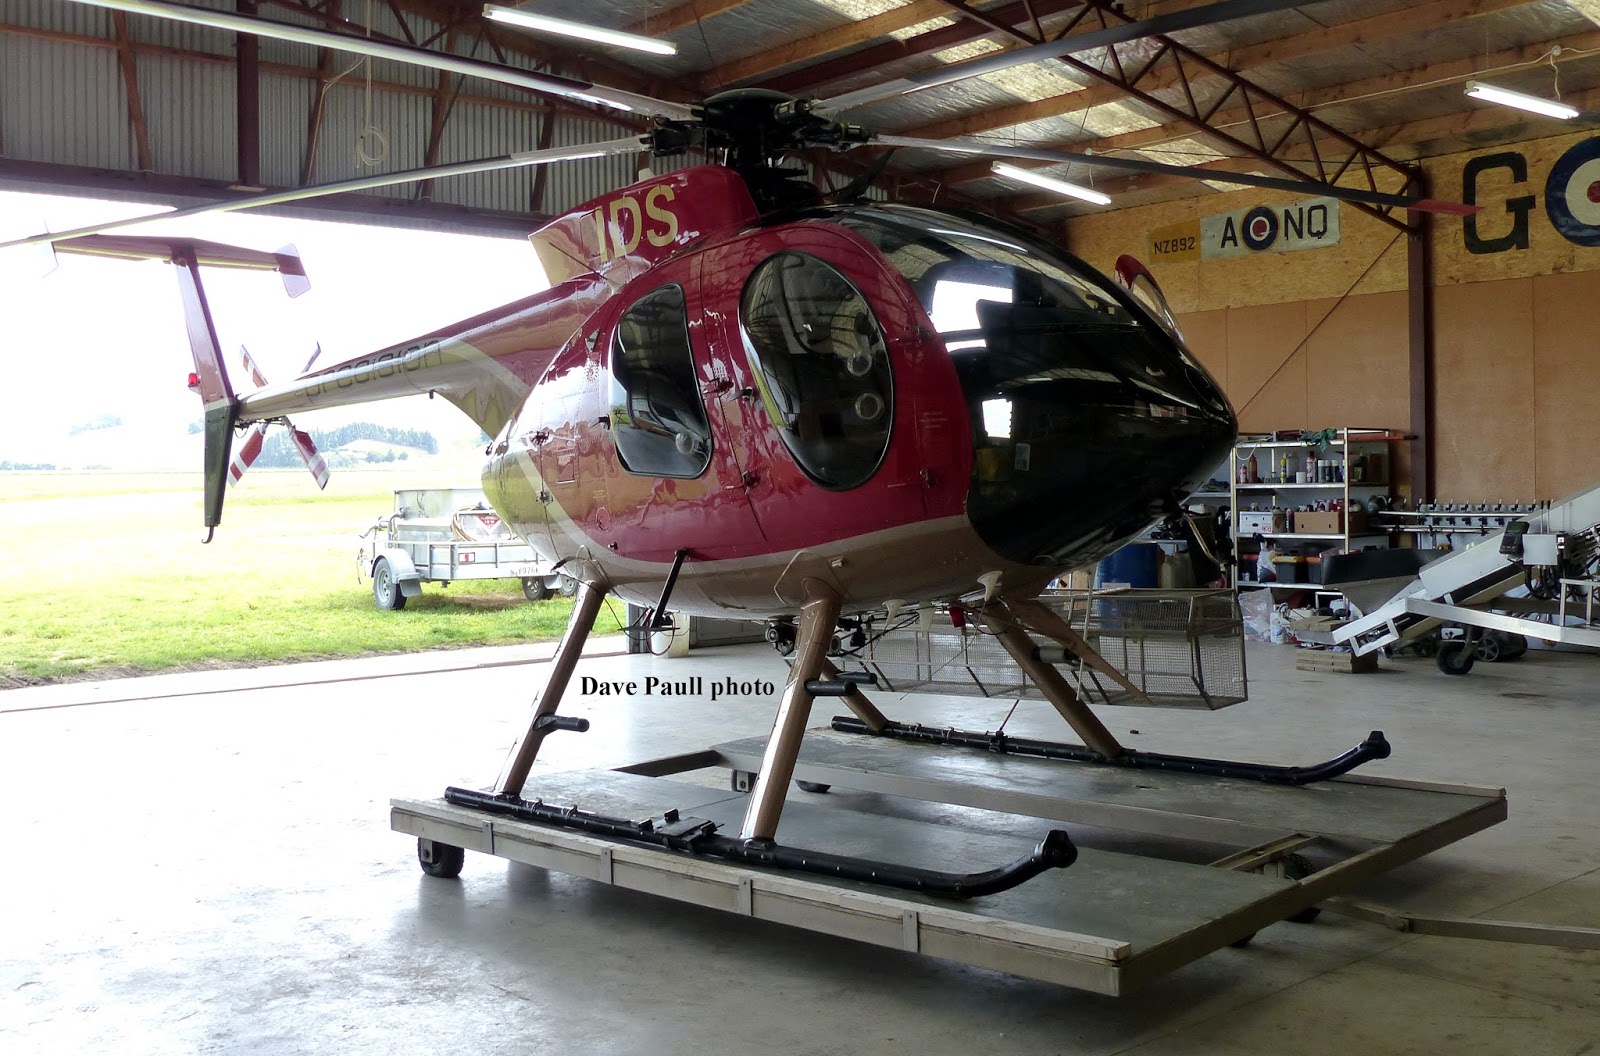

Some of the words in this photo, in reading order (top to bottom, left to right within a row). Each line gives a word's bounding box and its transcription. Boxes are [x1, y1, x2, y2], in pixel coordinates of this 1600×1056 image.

[594, 185, 679, 262] IDS
[1463, 151, 1536, 255] G
[1153, 236, 1196, 255] NZ892
